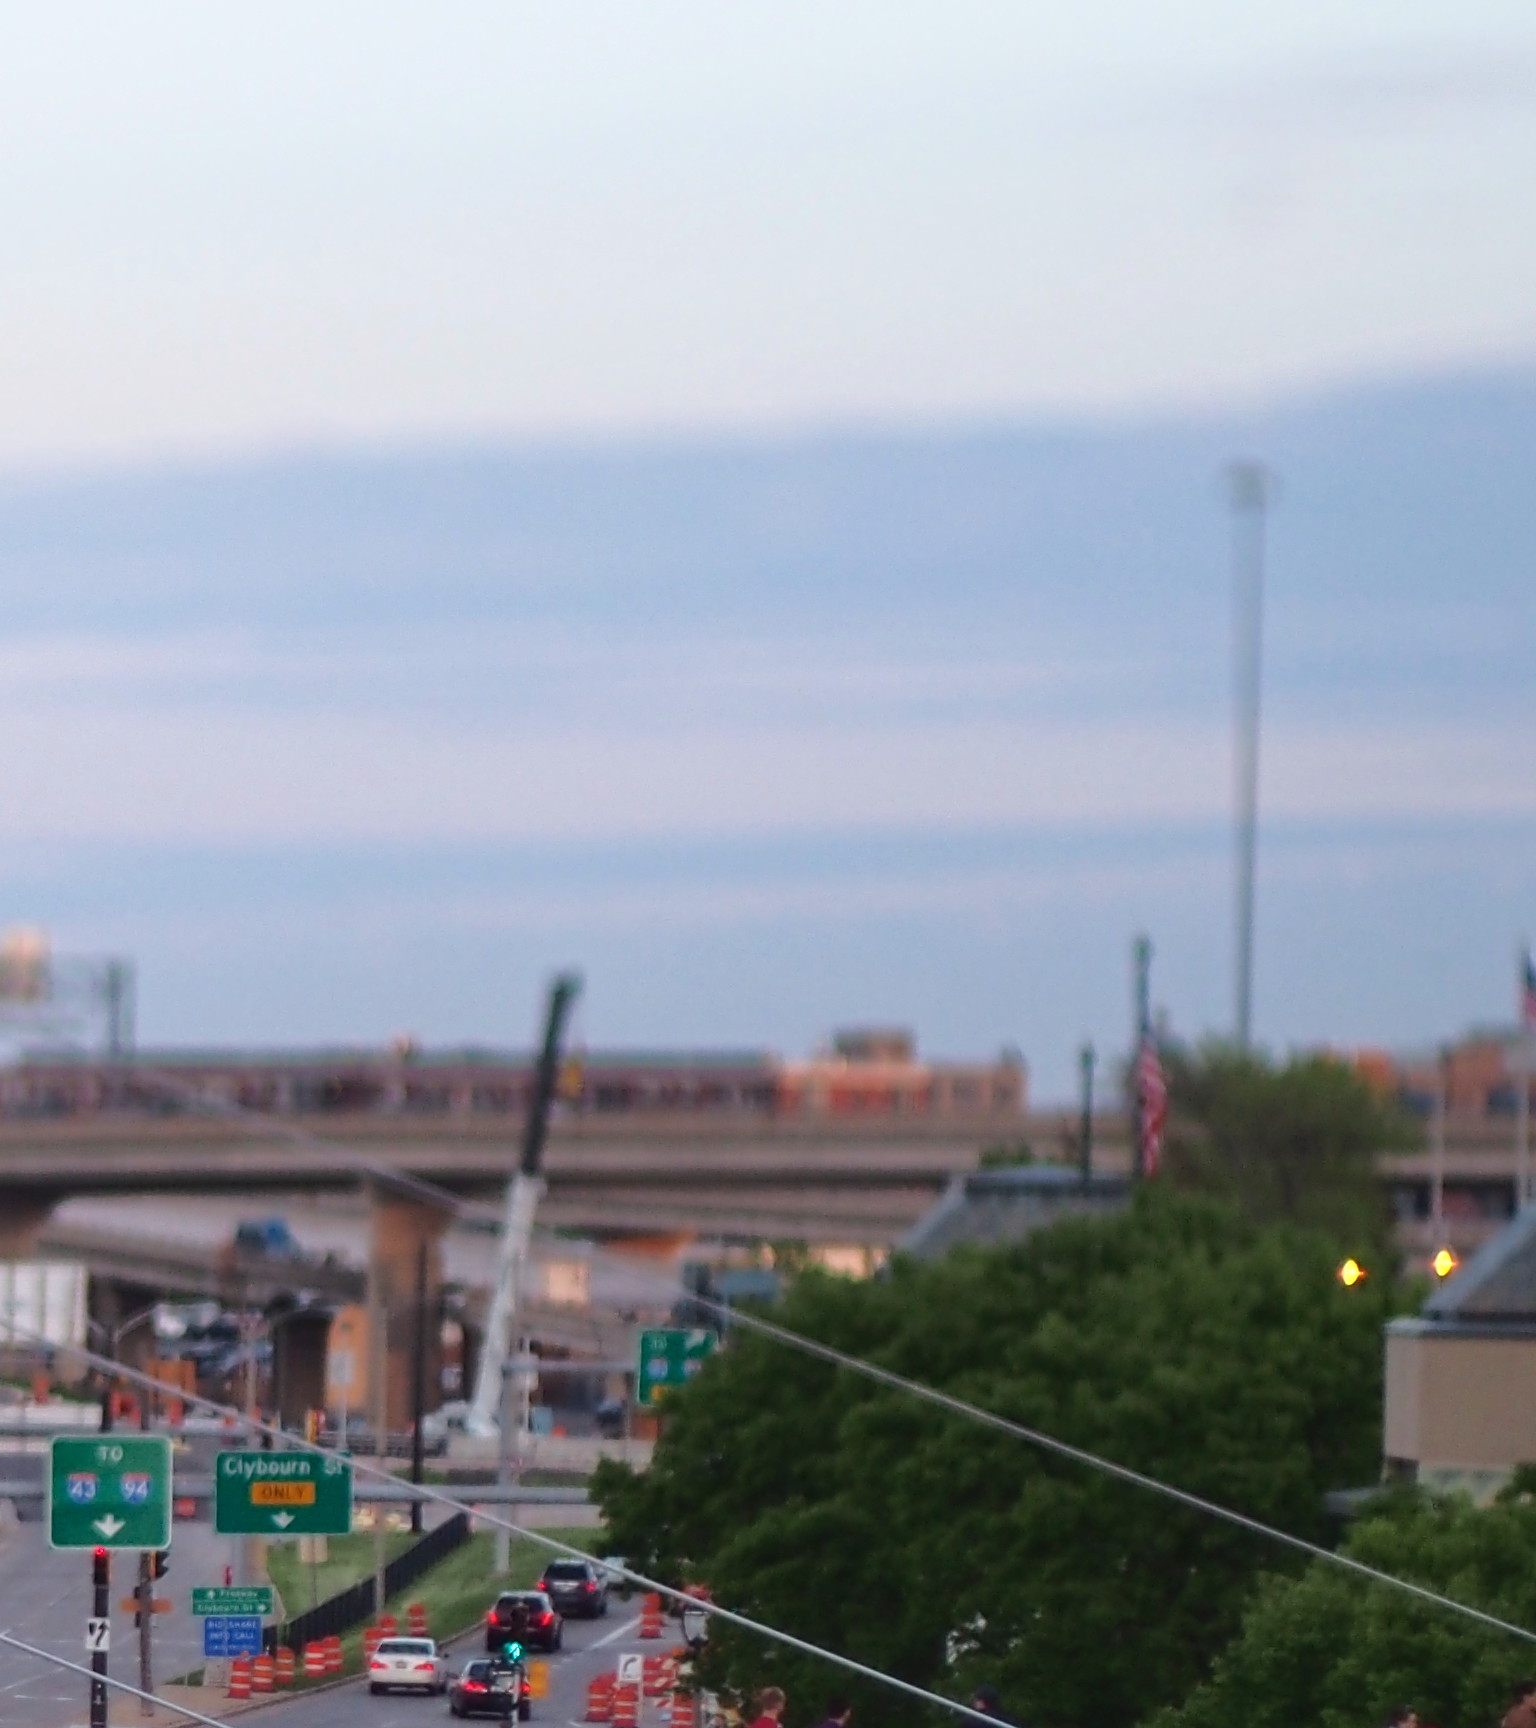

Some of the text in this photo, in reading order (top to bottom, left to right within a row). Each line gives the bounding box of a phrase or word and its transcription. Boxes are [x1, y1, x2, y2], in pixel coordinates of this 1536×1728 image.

[97, 1445, 124, 1462] TO
[224, 1457, 344, 1478] Clybourn St
[71, 1479, 148, 1499] 43 94
[261, 1485, 306, 1500] ONLY
[220, 1588, 258, 1598] Freeway
[197, 1604, 240, 1613] Clybourn
